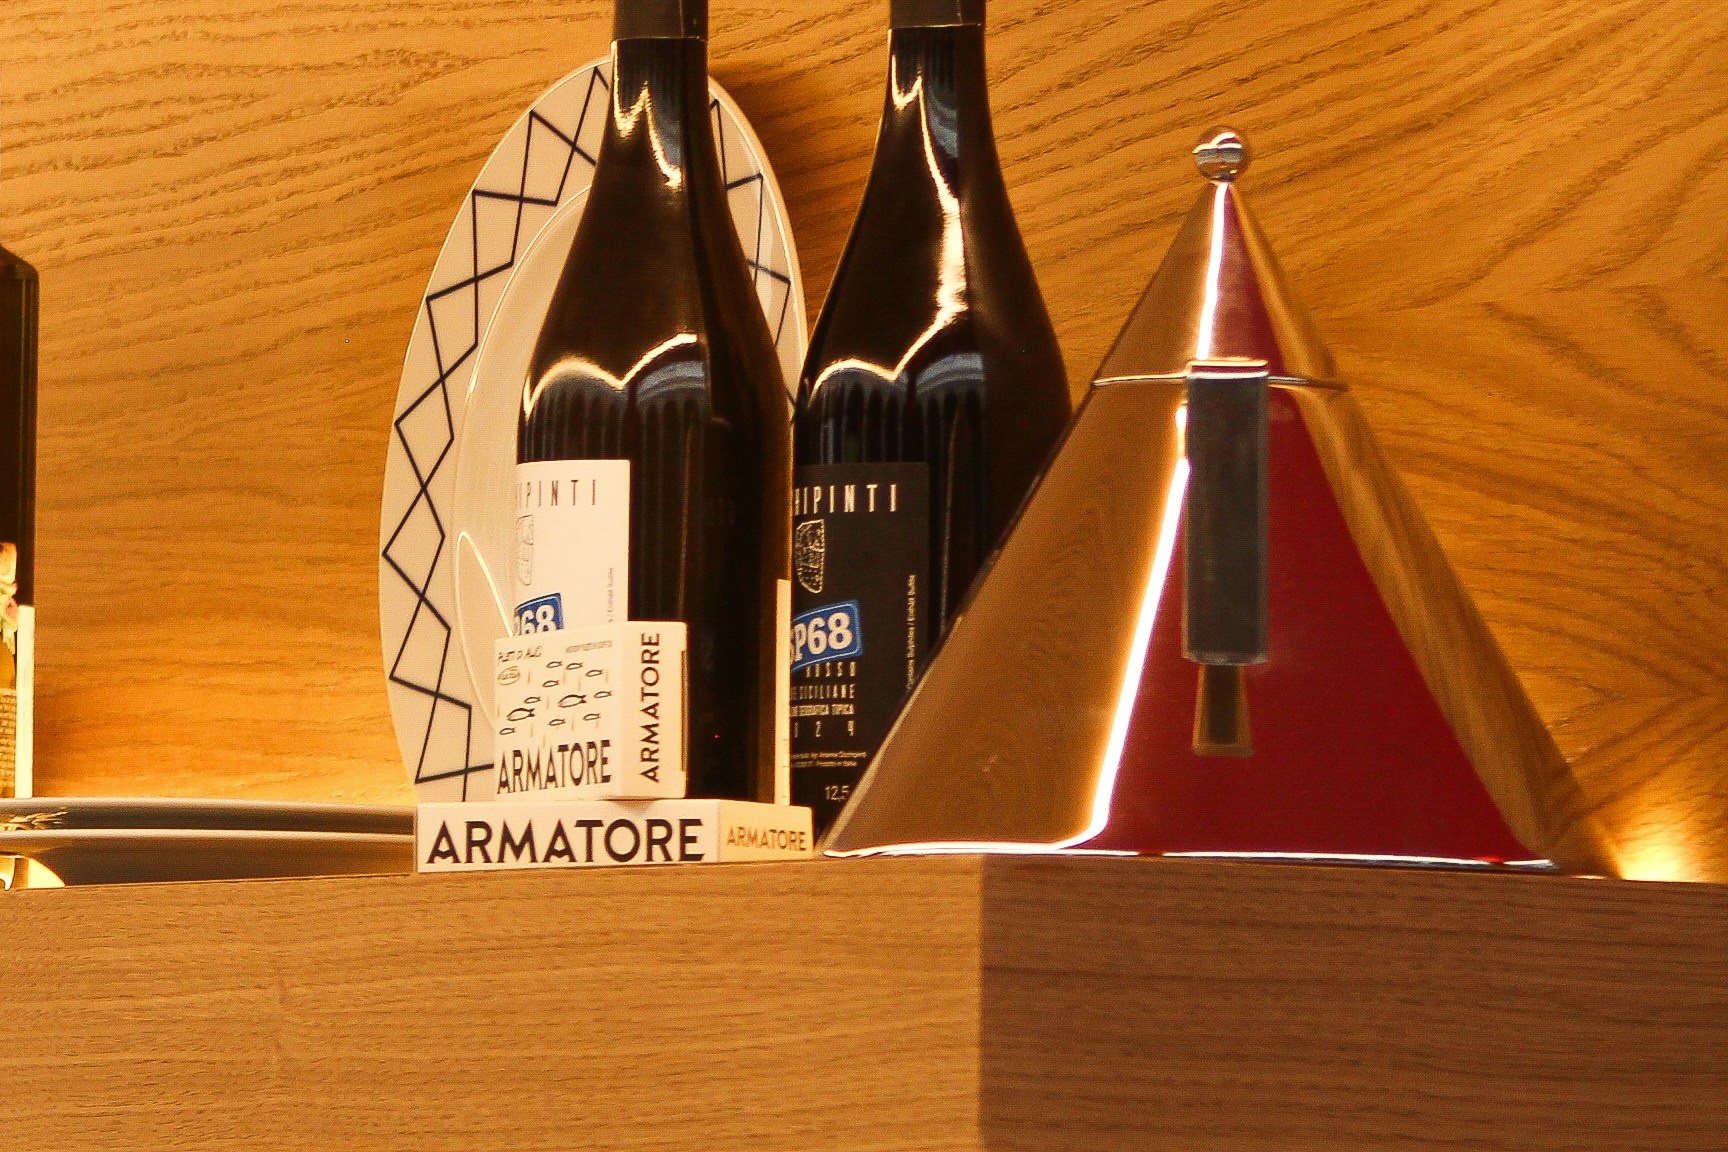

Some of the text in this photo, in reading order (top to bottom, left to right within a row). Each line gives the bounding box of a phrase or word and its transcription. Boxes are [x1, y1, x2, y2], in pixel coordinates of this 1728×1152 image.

[639, 632, 660, 784] ARMATORE
[496, 739, 612, 795] ARMATORE
[426, 818, 705, 865] ARMATORE
[726, 827, 807, 852] ARMATORE
